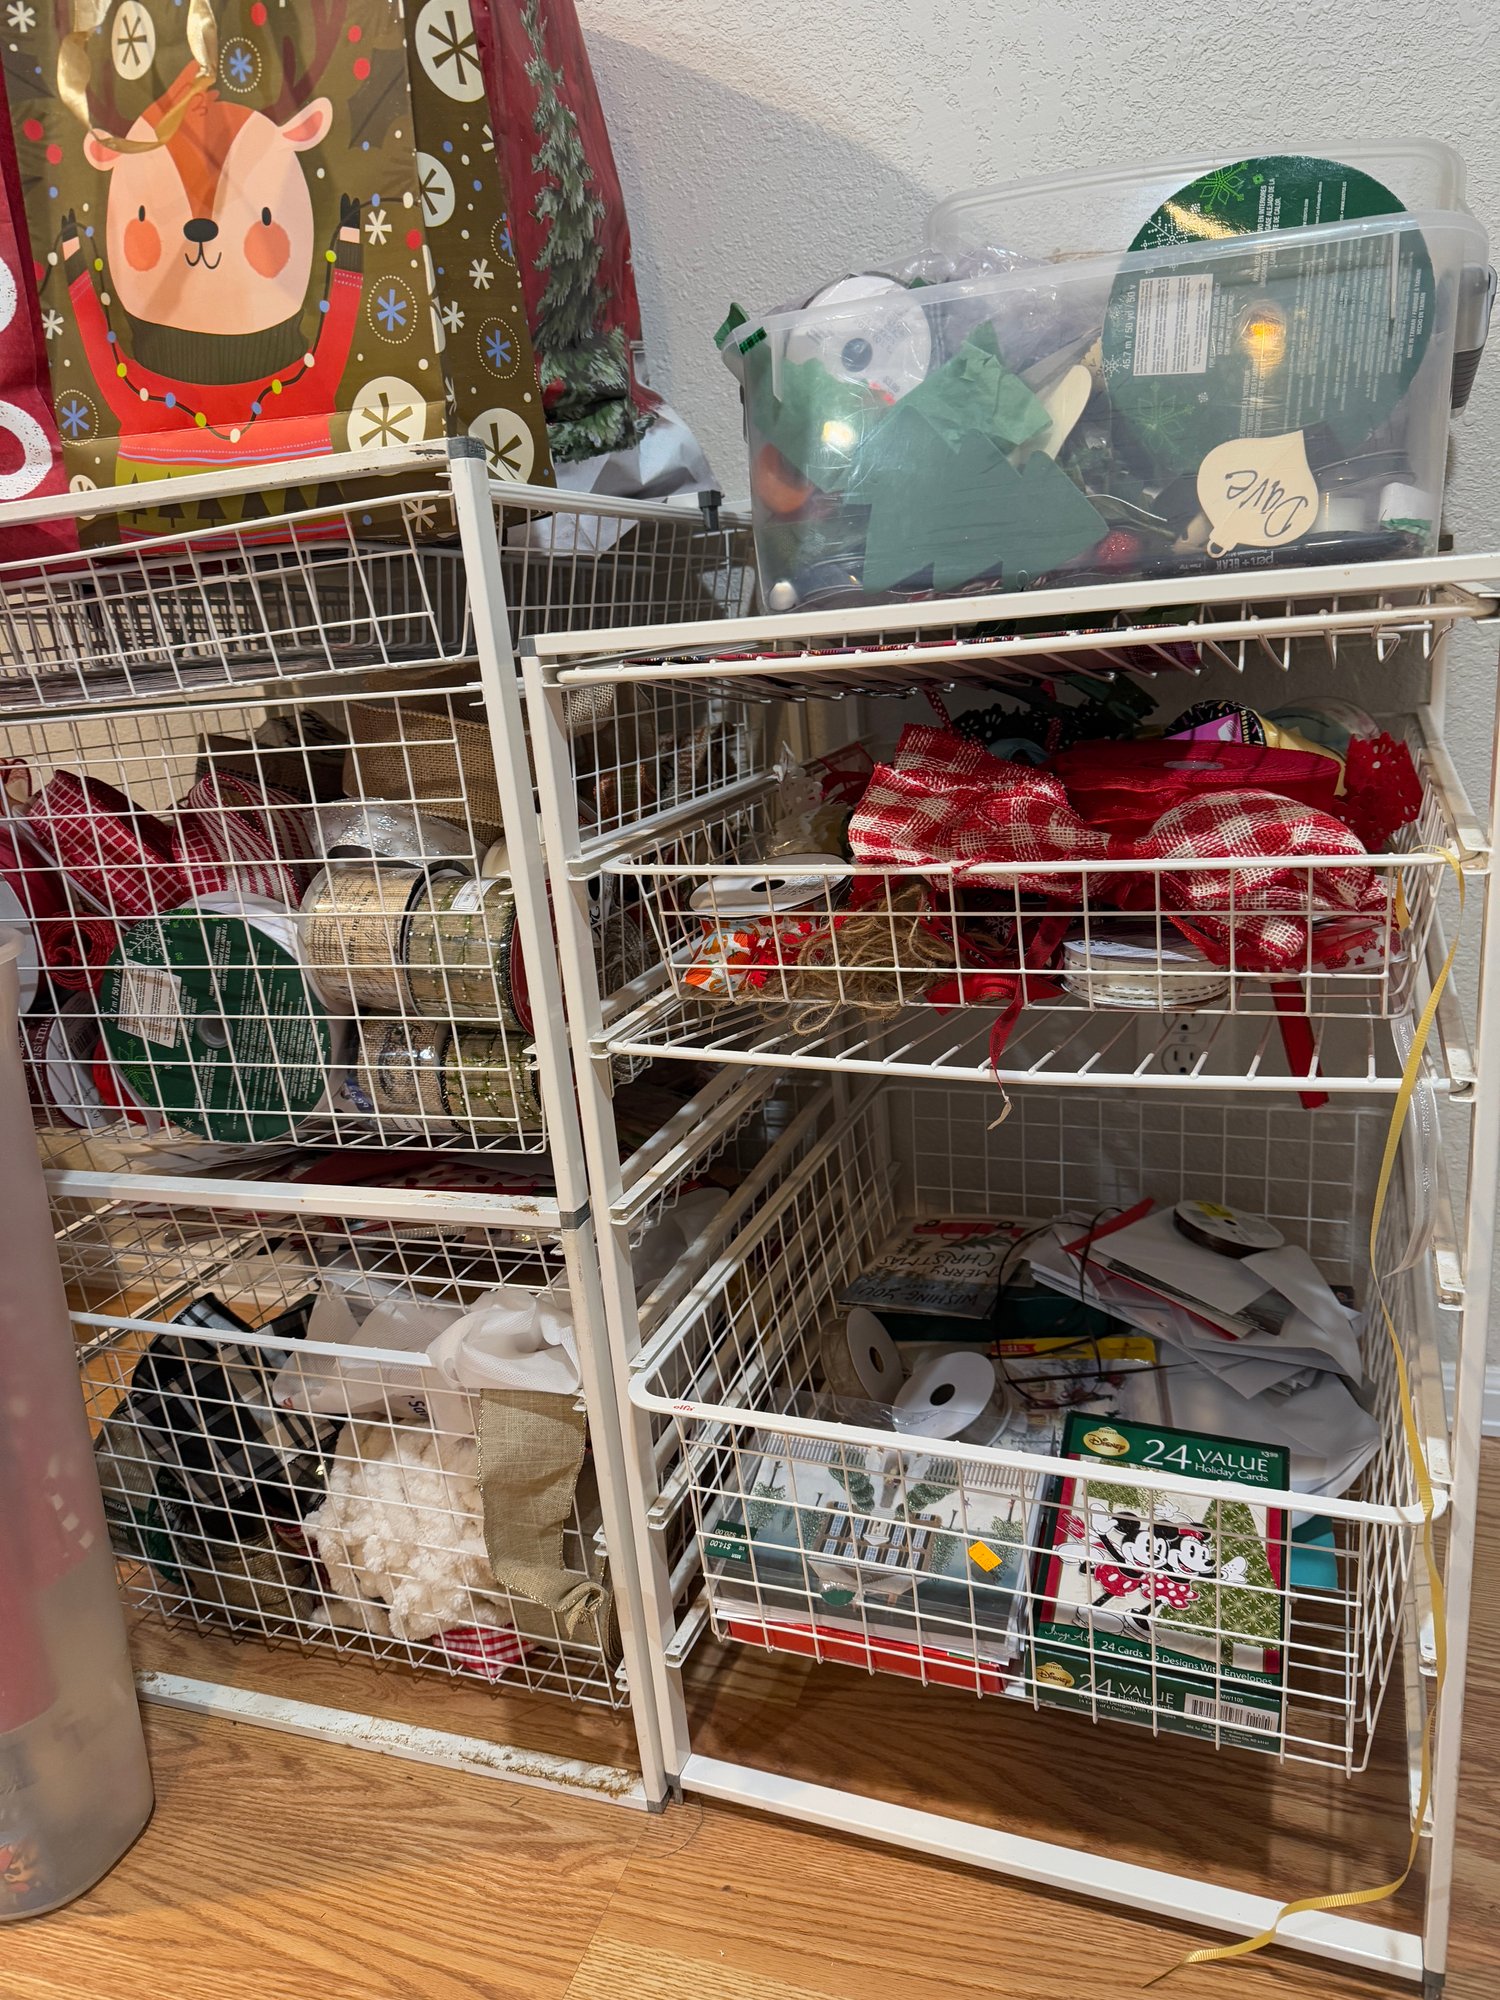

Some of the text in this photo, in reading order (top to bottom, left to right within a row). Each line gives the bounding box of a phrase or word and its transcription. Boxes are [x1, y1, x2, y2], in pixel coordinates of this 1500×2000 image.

[1258, 185, 1267, 214] INTERIORES
[1265, 193, 1274, 217] ALEJADO
[1125, 322, 1133, 333] 50
[1225, 470, 1308, 537] Dave
[1251, 551, 1274, 565] pen
[112, 987, 119, 996] 50
[878, 1250, 997, 1267] CHRISTMAS
[930, 1264, 999, 1278] MERRY
[858, 1287, 979, 1307] WISHING YOU
[1088, 1433, 1126, 1453] Disney
[1142, 1439, 1269, 1473] 24 VALUE
[1195, 1462, 1269, 1482] Holiday Cards
[709, 1539, 732, 1550] $14.00
[1101, 1640, 1116, 1651] 24
[1117, 1645, 1143, 1658] Cards
[1162, 1654, 1199, 1670] Designs
[1224, 1668, 1273, 1686] Envelopes
[1037, 1668, 1071, 1685] Disney
[1077, 1673, 1116, 1698] 24
